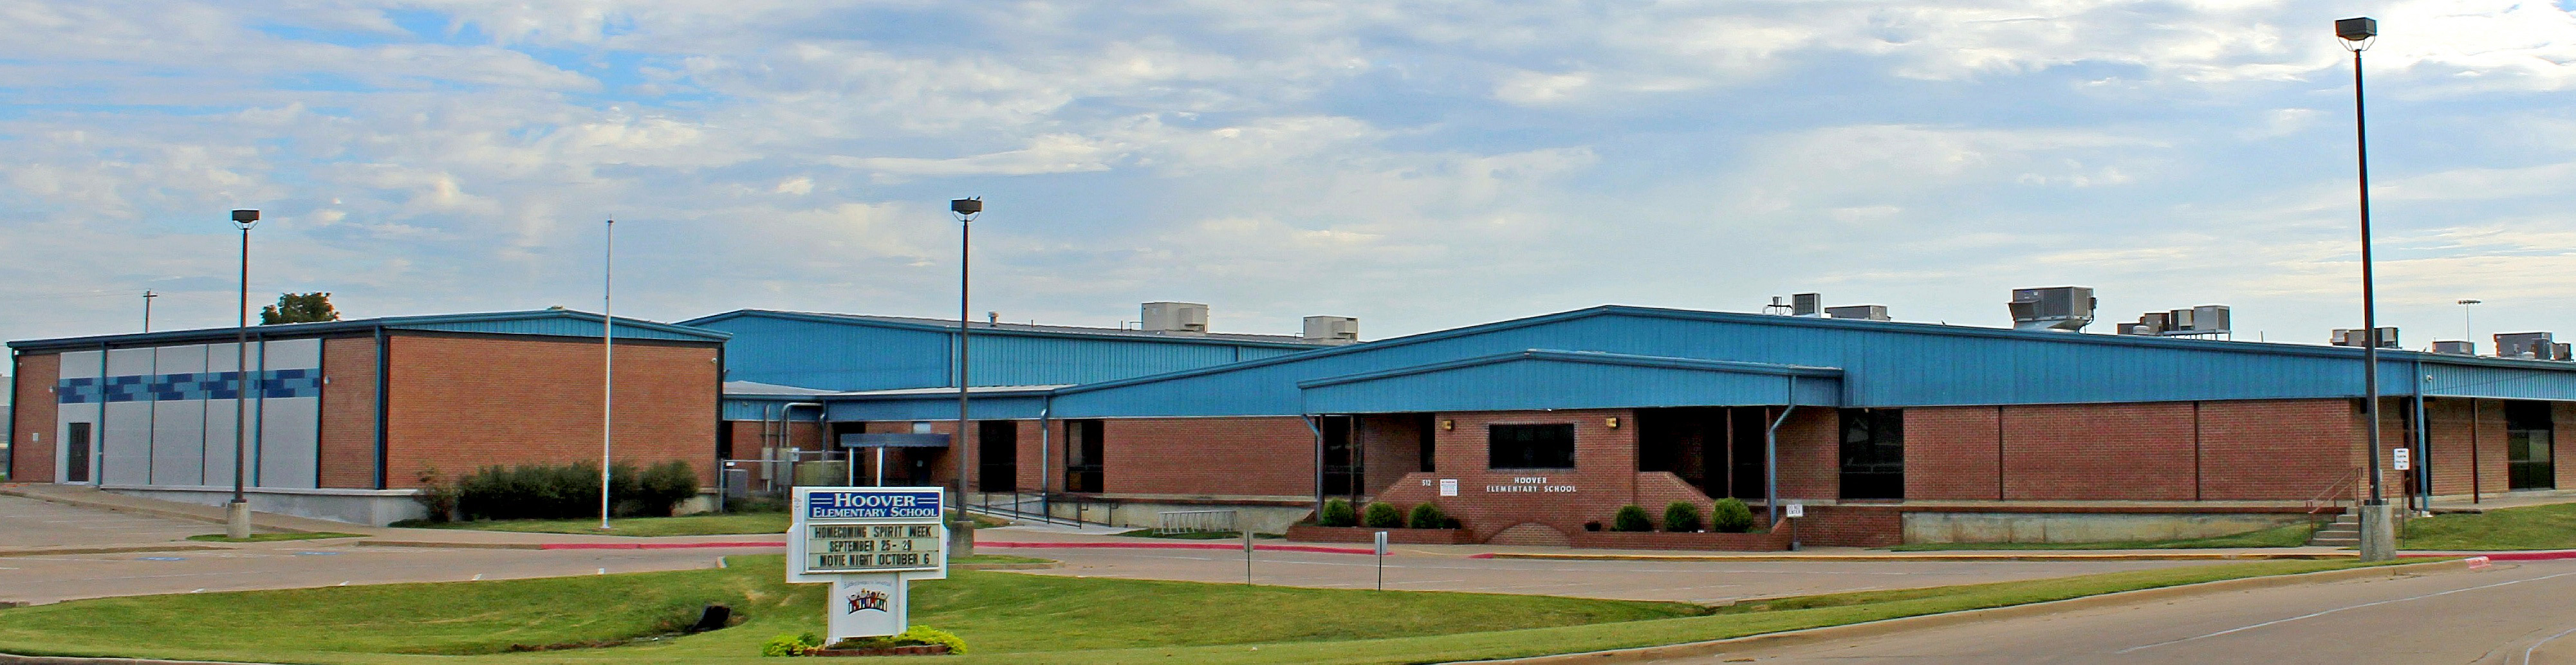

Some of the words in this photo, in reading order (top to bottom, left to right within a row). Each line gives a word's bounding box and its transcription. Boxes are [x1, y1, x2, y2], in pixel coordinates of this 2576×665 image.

[835, 493, 916, 507] HOOVER
[813, 507, 887, 517] ELEMENTARY
[891, 507, 937, 516] SCHOOL
[815, 527, 867, 538] HOMECOMING
[874, 526, 903, 537] SPIRIT
[909, 525, 931, 537] WEEK
[829, 540, 875, 552] SEPTEMBER
[820, 554, 846, 566] MOVIE
[850, 554, 873, 565] NIGHT
[879, 553, 918, 565] OCTOBER
[924, 553, 929, 564] 6
